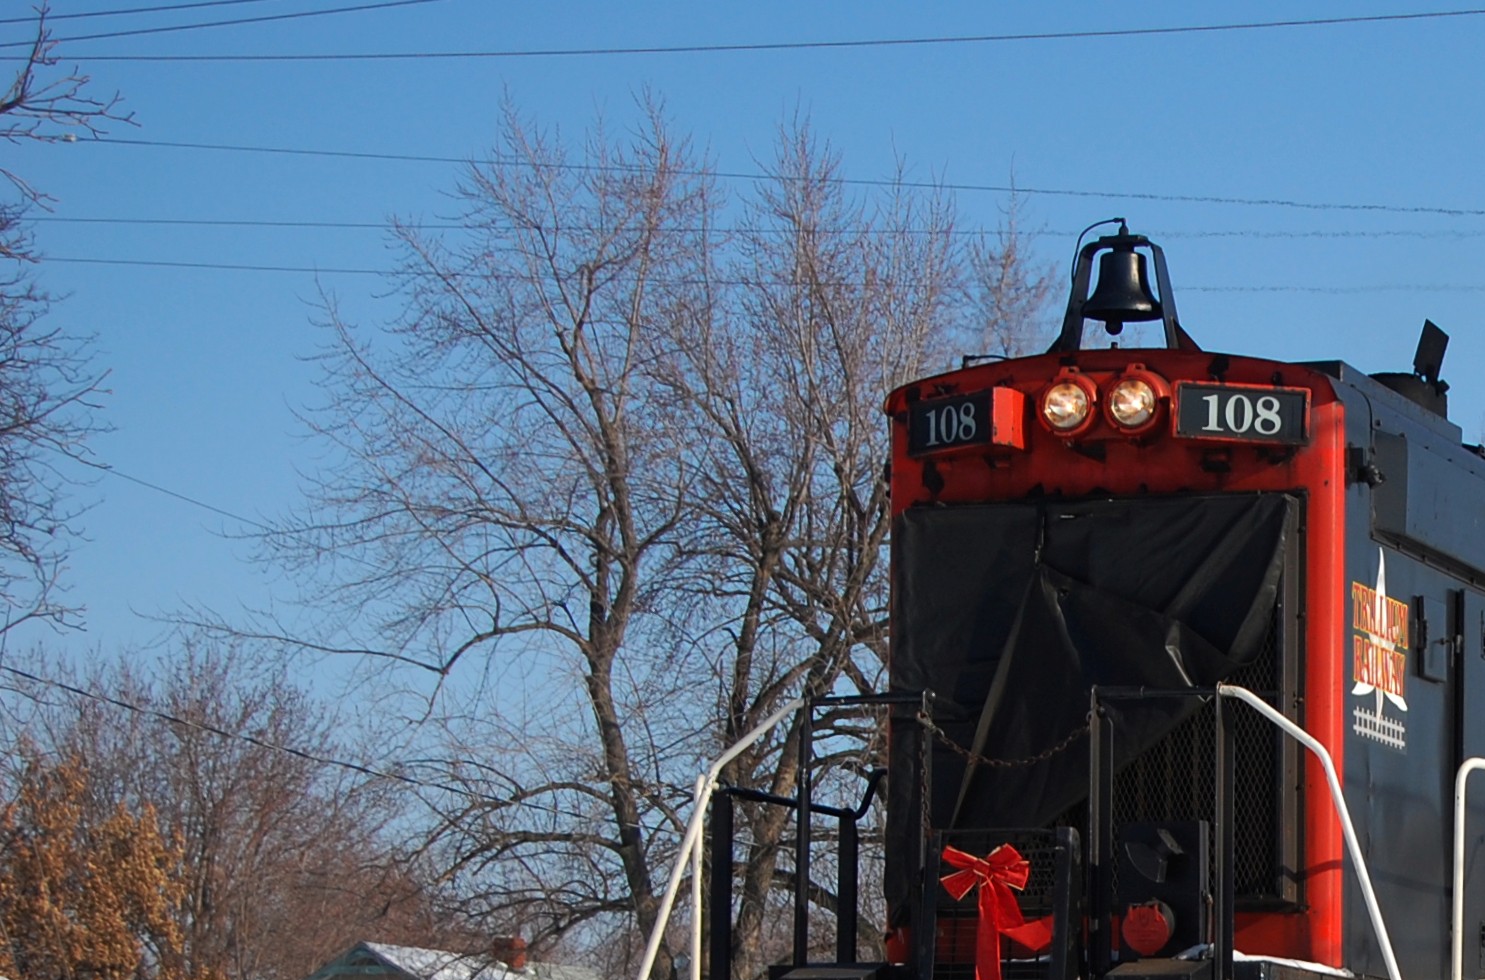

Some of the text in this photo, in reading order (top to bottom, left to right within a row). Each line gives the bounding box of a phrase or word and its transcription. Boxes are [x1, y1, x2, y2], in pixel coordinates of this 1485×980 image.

[925, 402, 976, 446] 108
[1202, 394, 1282, 435] 108
[1352, 581, 1408, 650] TRILLIUM
[1353, 635, 1405, 697] RAILWAY
